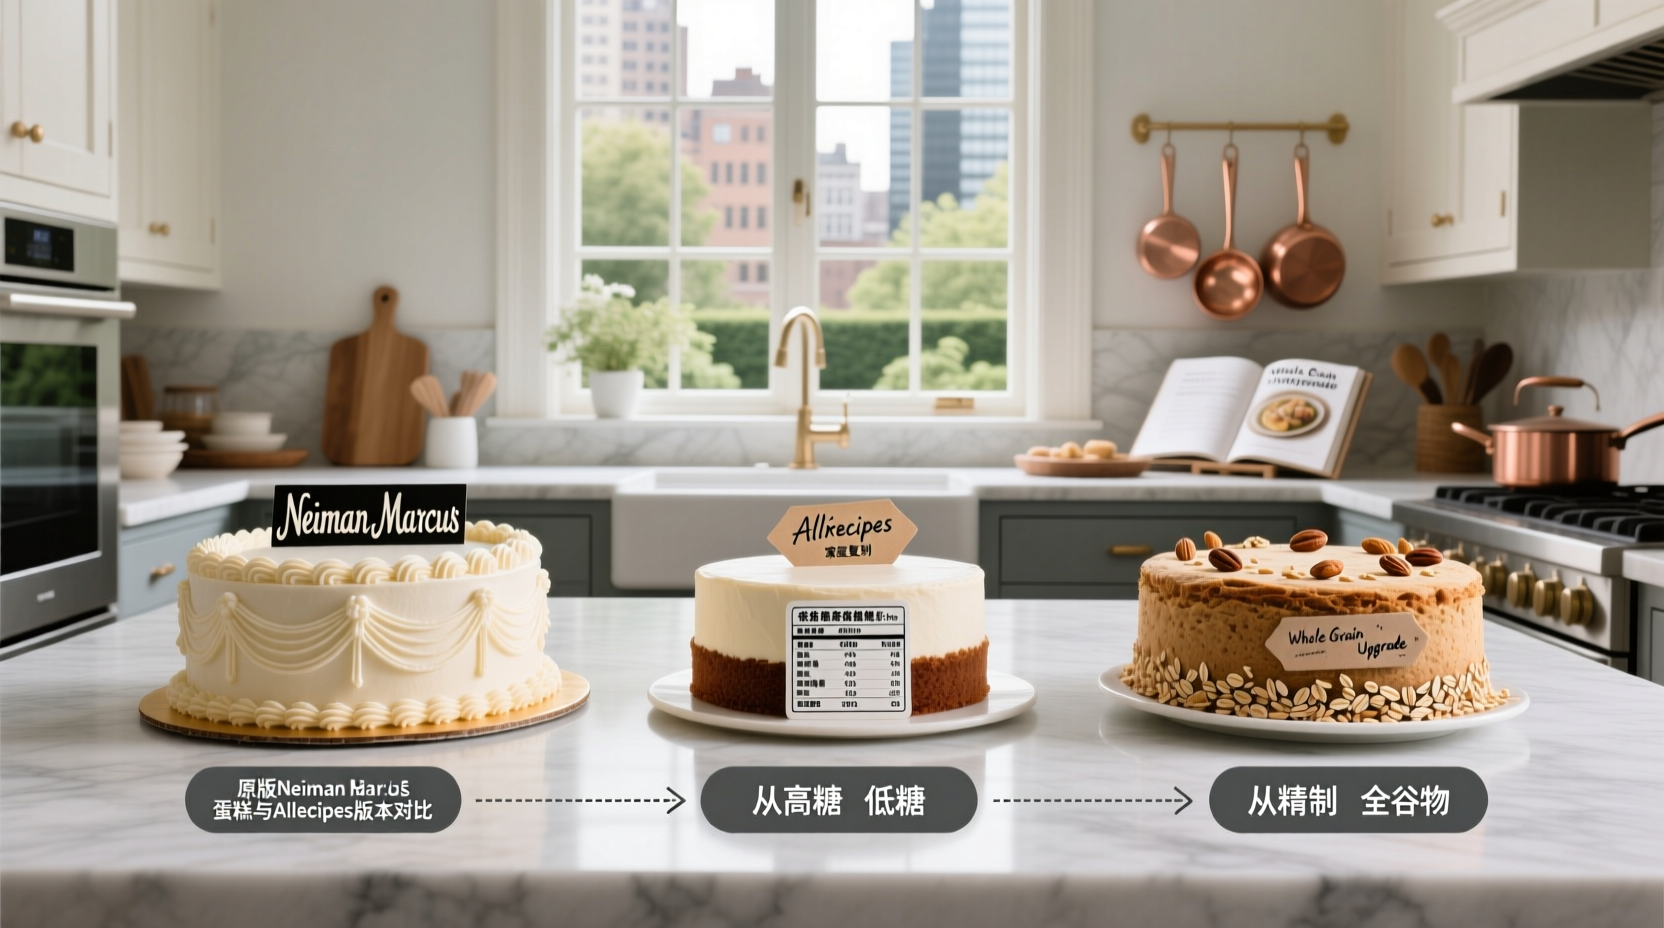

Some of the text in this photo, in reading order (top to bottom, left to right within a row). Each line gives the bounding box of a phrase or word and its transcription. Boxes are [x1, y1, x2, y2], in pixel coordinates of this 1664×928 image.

[276, 491, 460, 541] Neiman Marcus
[1288, 626, 1364, 645] Whole Grain
[1357, 634, 1408, 661] Upgrade
